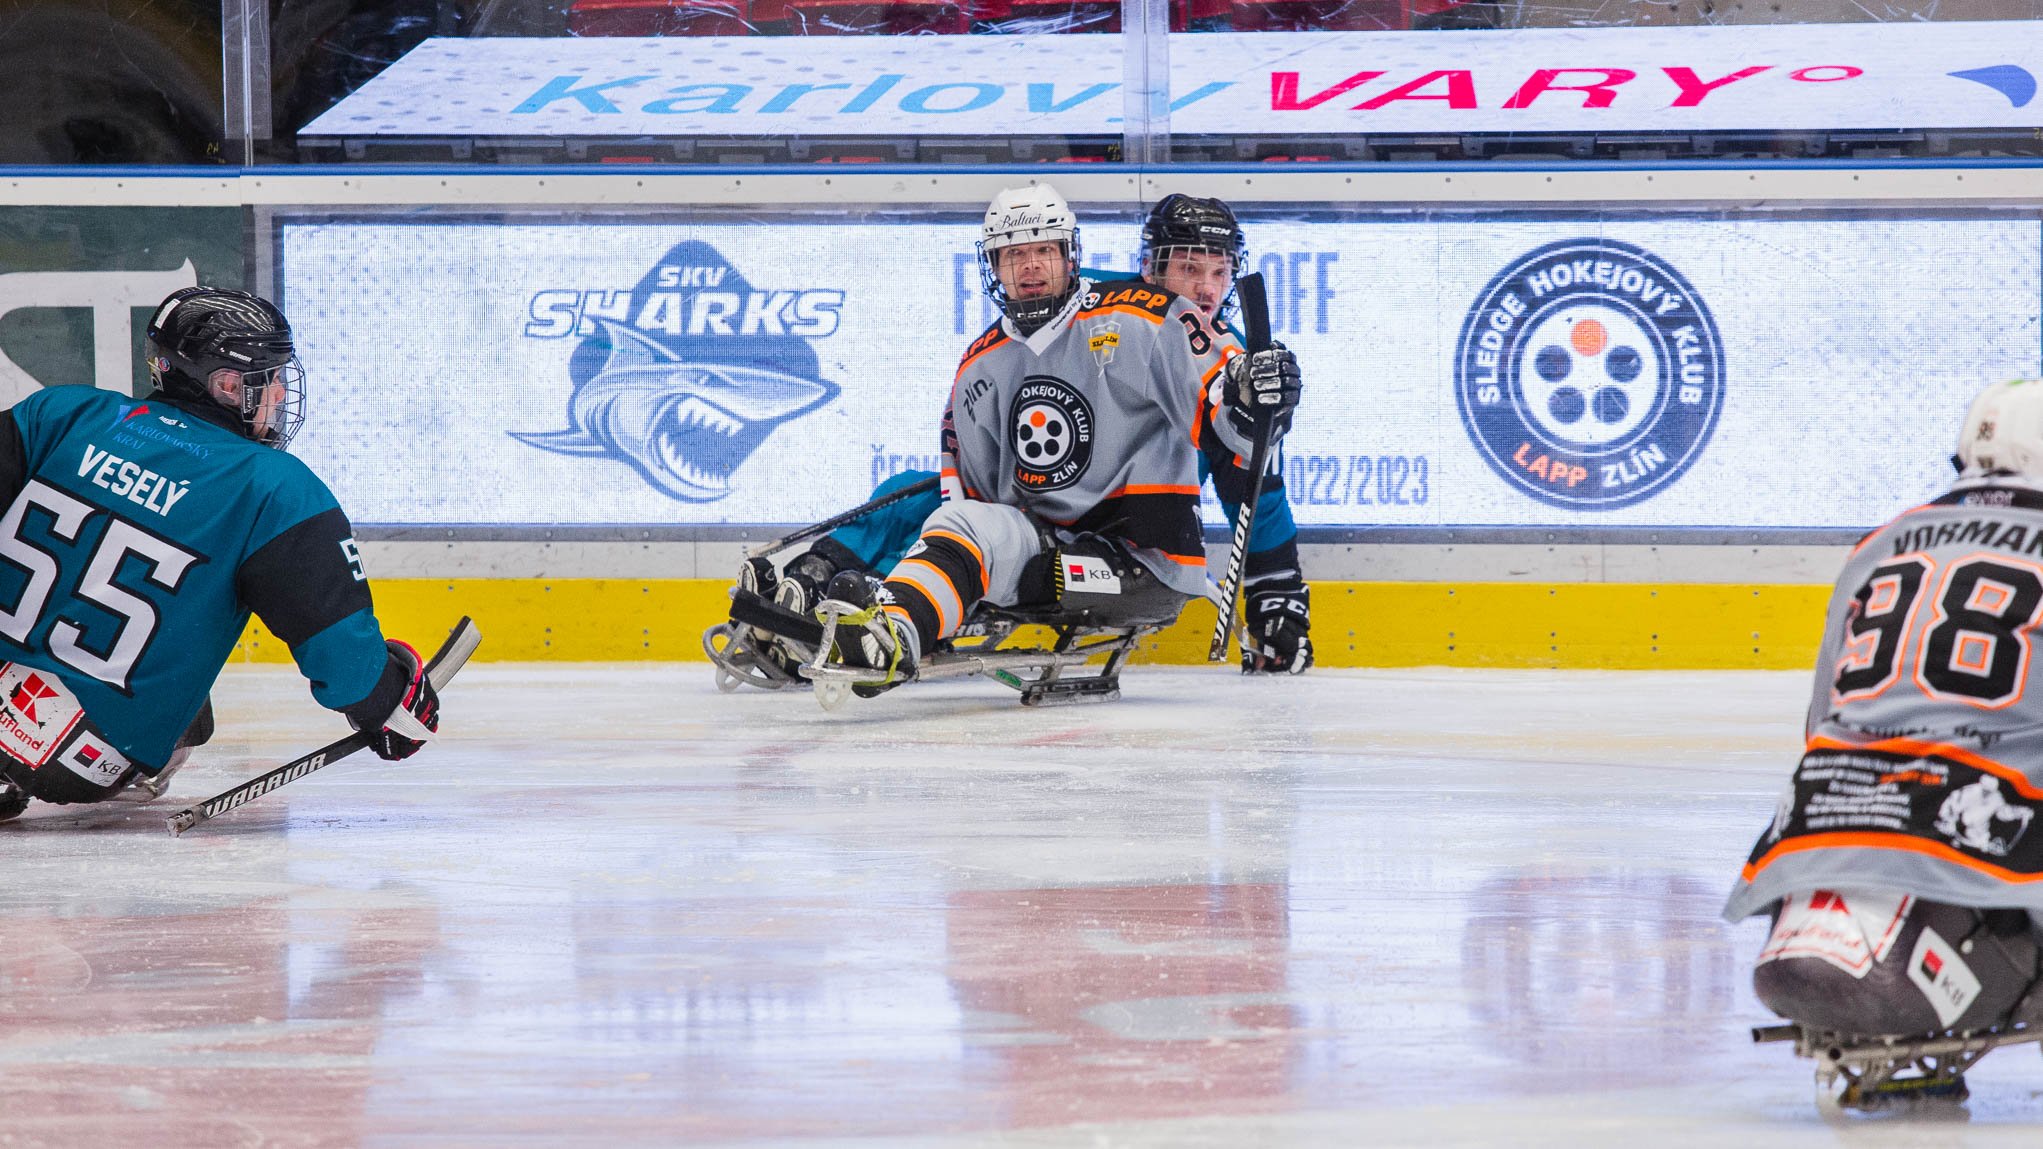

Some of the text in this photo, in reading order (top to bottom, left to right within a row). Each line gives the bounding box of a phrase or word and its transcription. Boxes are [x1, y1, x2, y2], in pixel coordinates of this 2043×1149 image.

[509, 74, 1237, 122] Karlovy
[656, 266, 726, 288] SKV
[1101, 288, 1168, 309] LAPP
[523, 288, 846, 339] SHARKS
[1475, 259, 1706, 405] SLEDGE HOKEJOVÝ KLUB
[1021, 385, 1089, 443] OKEJOVÝ KLUB
[77, 443, 192, 517] VESELÝ
[1018, 460, 1079, 485] LAPP ZLÍN
[1288, 455, 1429, 505] 022/2023
[1512, 441, 1667, 488] LAPP ZLÍN
[0, 477, 210, 698] 55
[1089, 569, 1112, 580] KB
[1831, 551, 2043, 706] 98
[0, 711, 45, 752] ufland
[98, 760, 121, 775] KB
[204, 752, 327, 819] WARRIOR
